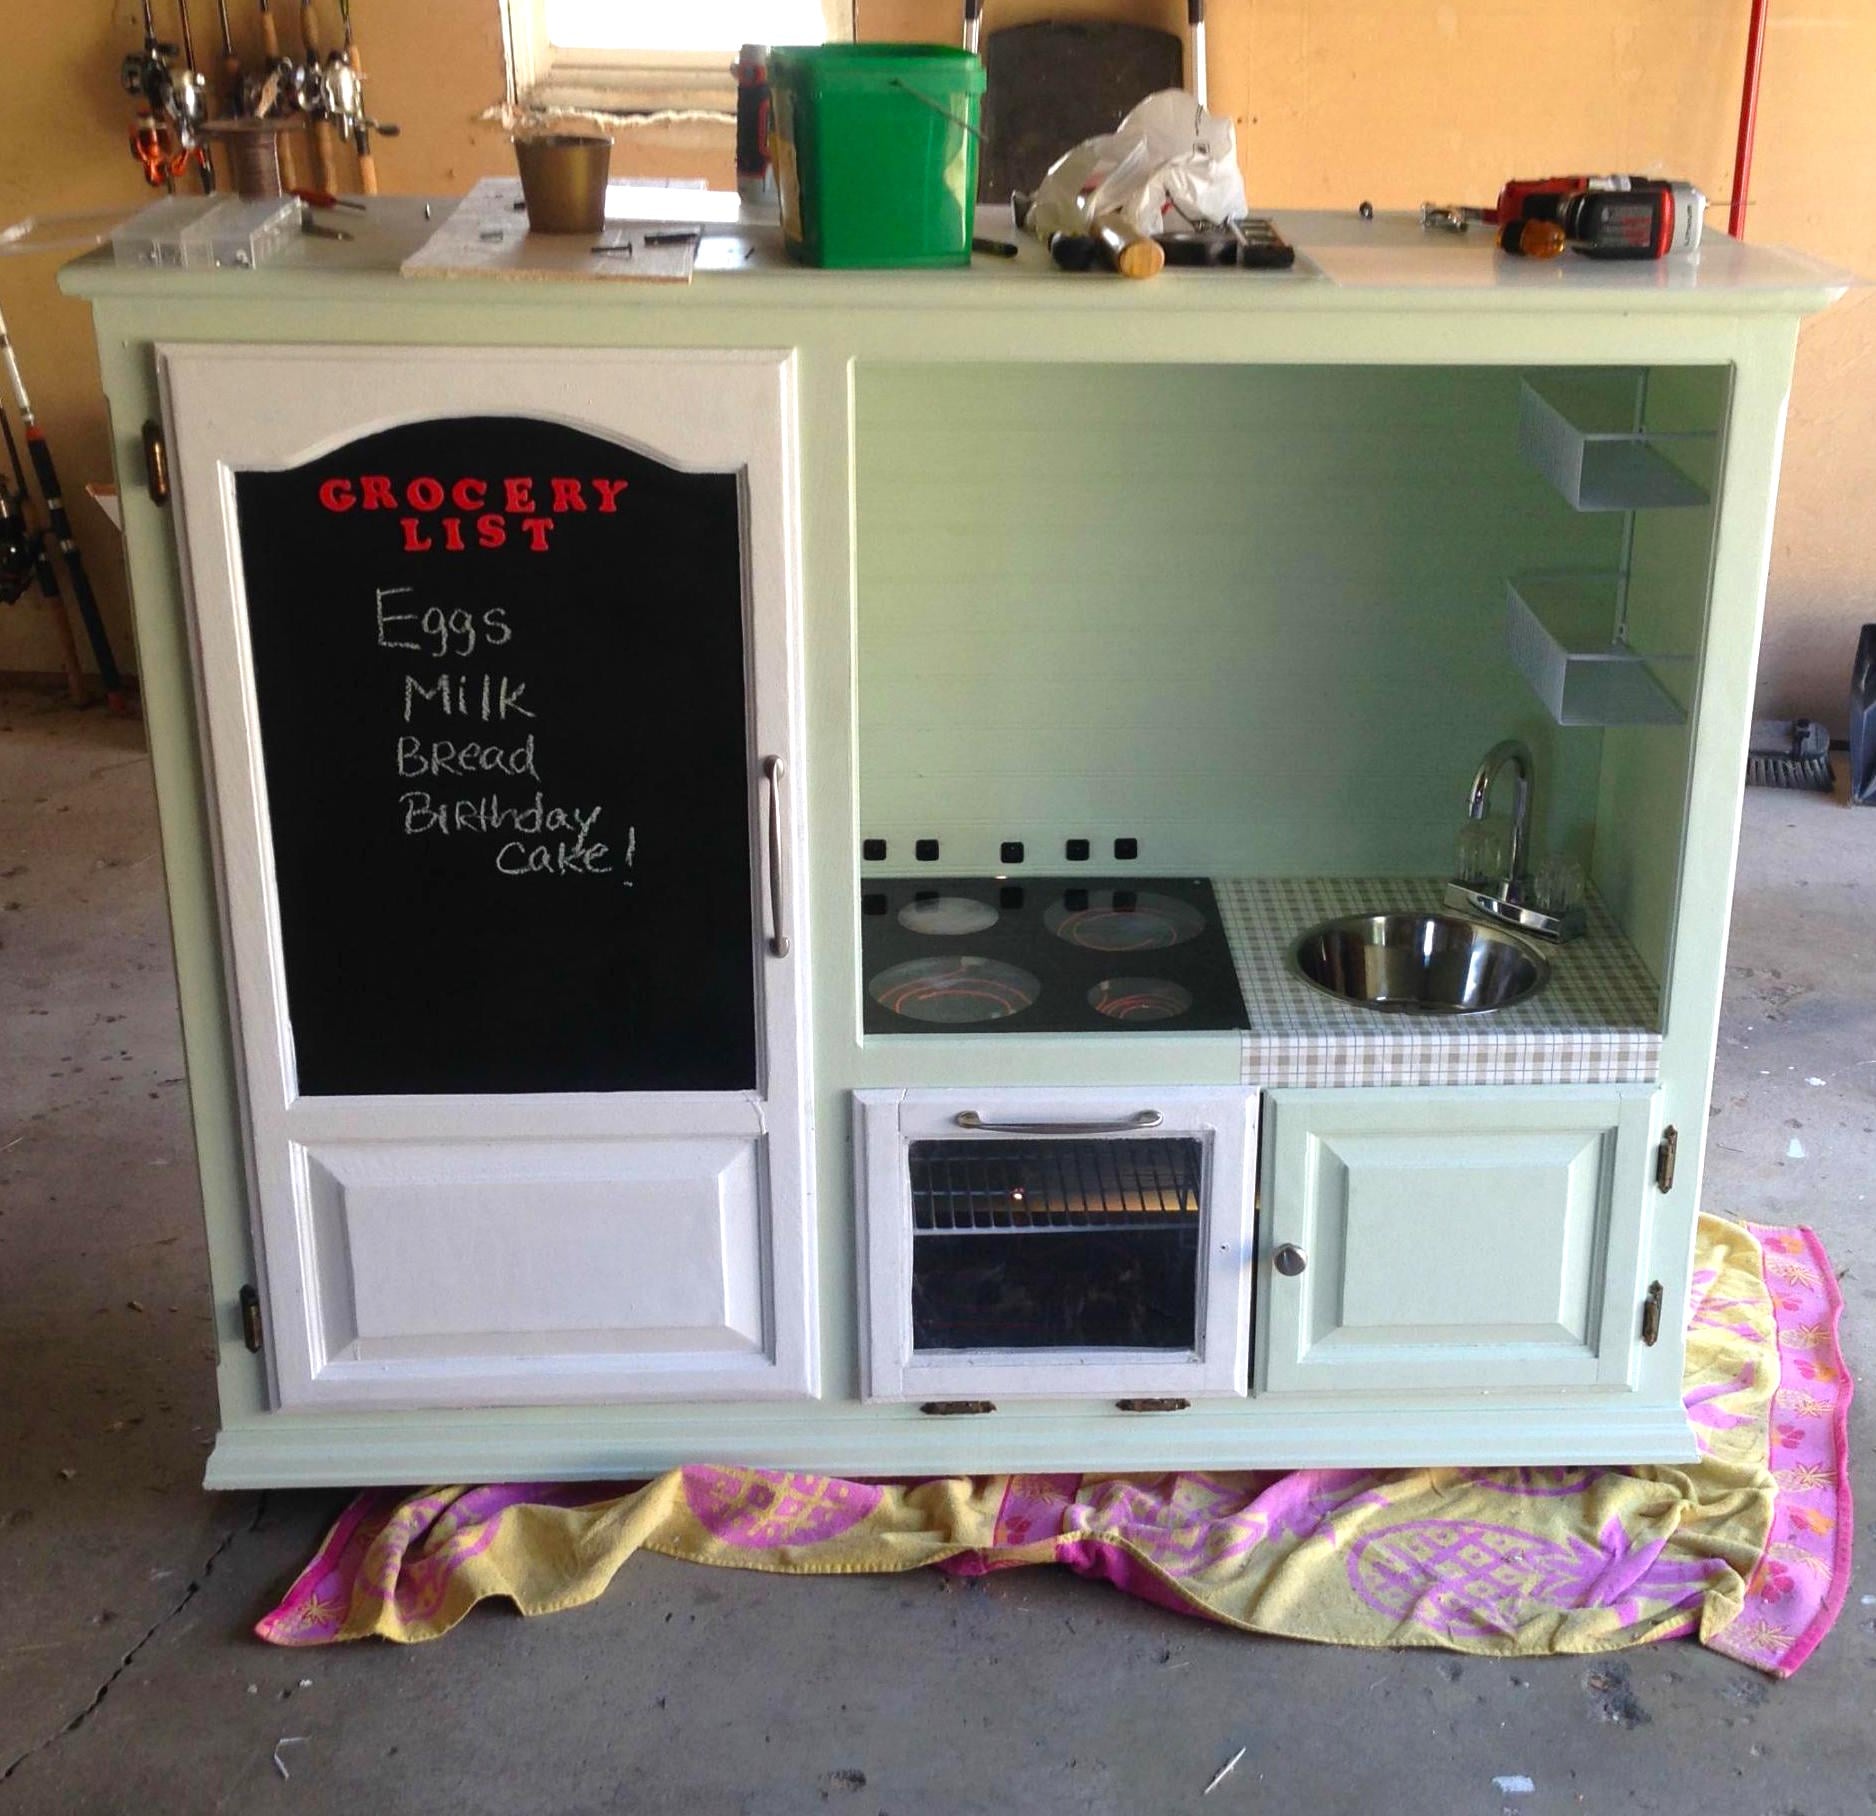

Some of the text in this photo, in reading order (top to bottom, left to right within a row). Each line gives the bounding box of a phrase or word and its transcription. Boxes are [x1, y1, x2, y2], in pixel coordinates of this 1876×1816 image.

[319, 476, 628, 513] GROCERY
[401, 514, 555, 551] LIST
[376, 587, 512, 657] Eggs
[405, 674, 535, 722] Milk
